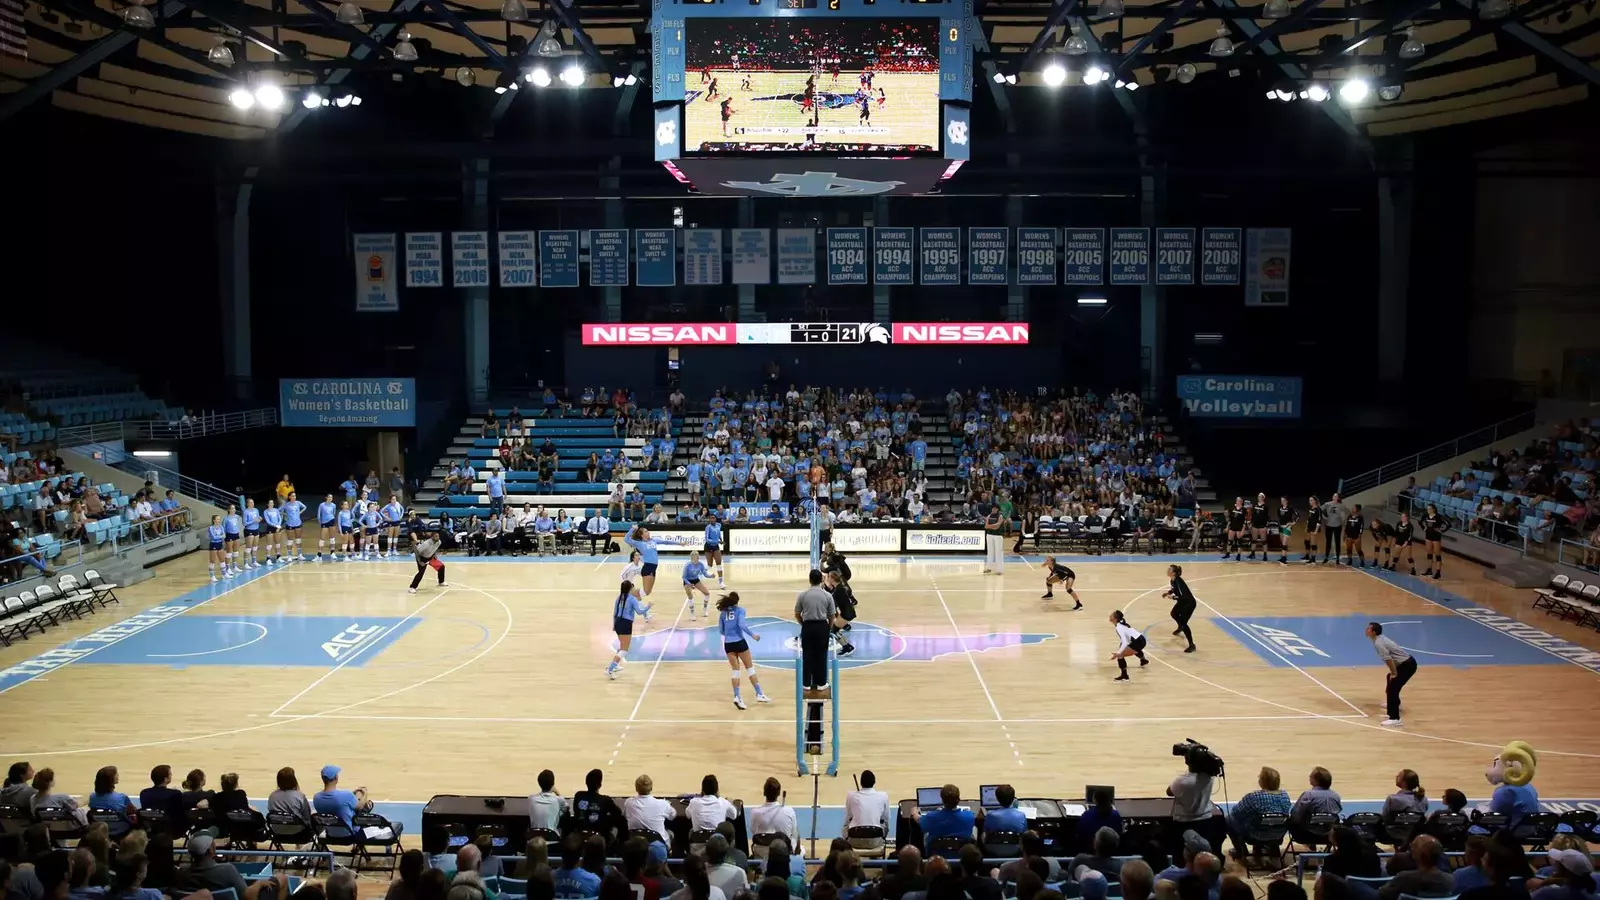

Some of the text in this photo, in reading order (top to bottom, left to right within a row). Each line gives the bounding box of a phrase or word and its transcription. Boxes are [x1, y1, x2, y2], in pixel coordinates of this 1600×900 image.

[950, 28, 958, 41] 0
[944, 73, 956, 81] FLS
[830, 250, 864, 265] 1984
[876, 250, 910, 265] 1994
[923, 250, 958, 265] 1995
[972, 250, 1005, 265] 1997
[1020, 250, 1054, 265] 1998
[1067, 250, 1101, 265] 2005
[1113, 250, 1147, 265] 2006
[1159, 250, 1192, 265] 2007
[1205, 251, 1238, 264] 2008
[410, 270, 439, 283] 1994
[455, 270, 487, 283] 2006
[504, 270, 533, 284] 2007
[592, 326, 726, 342] NISSAN
[842, 328, 857, 340] 21
[903, 326, 1028, 341] NISSAN
[313, 383, 382, 394] CAROLINA
[1037, 386, 1048, 396] 118
[1205, 378, 1274, 391] Carolina
[289, 398, 408, 410] Women's Basketball
[1186, 399, 1292, 416] Volleyball
[319, 415, 378, 424] Beyond Amazing
[925, 534, 980, 545] GoHeels.com
[77, 605, 188, 643] HEELS
[321, 623, 382, 658] ACC
[1250, 623, 1332, 658] ACC
[1456, 608, 1600, 671] CAROLIN
